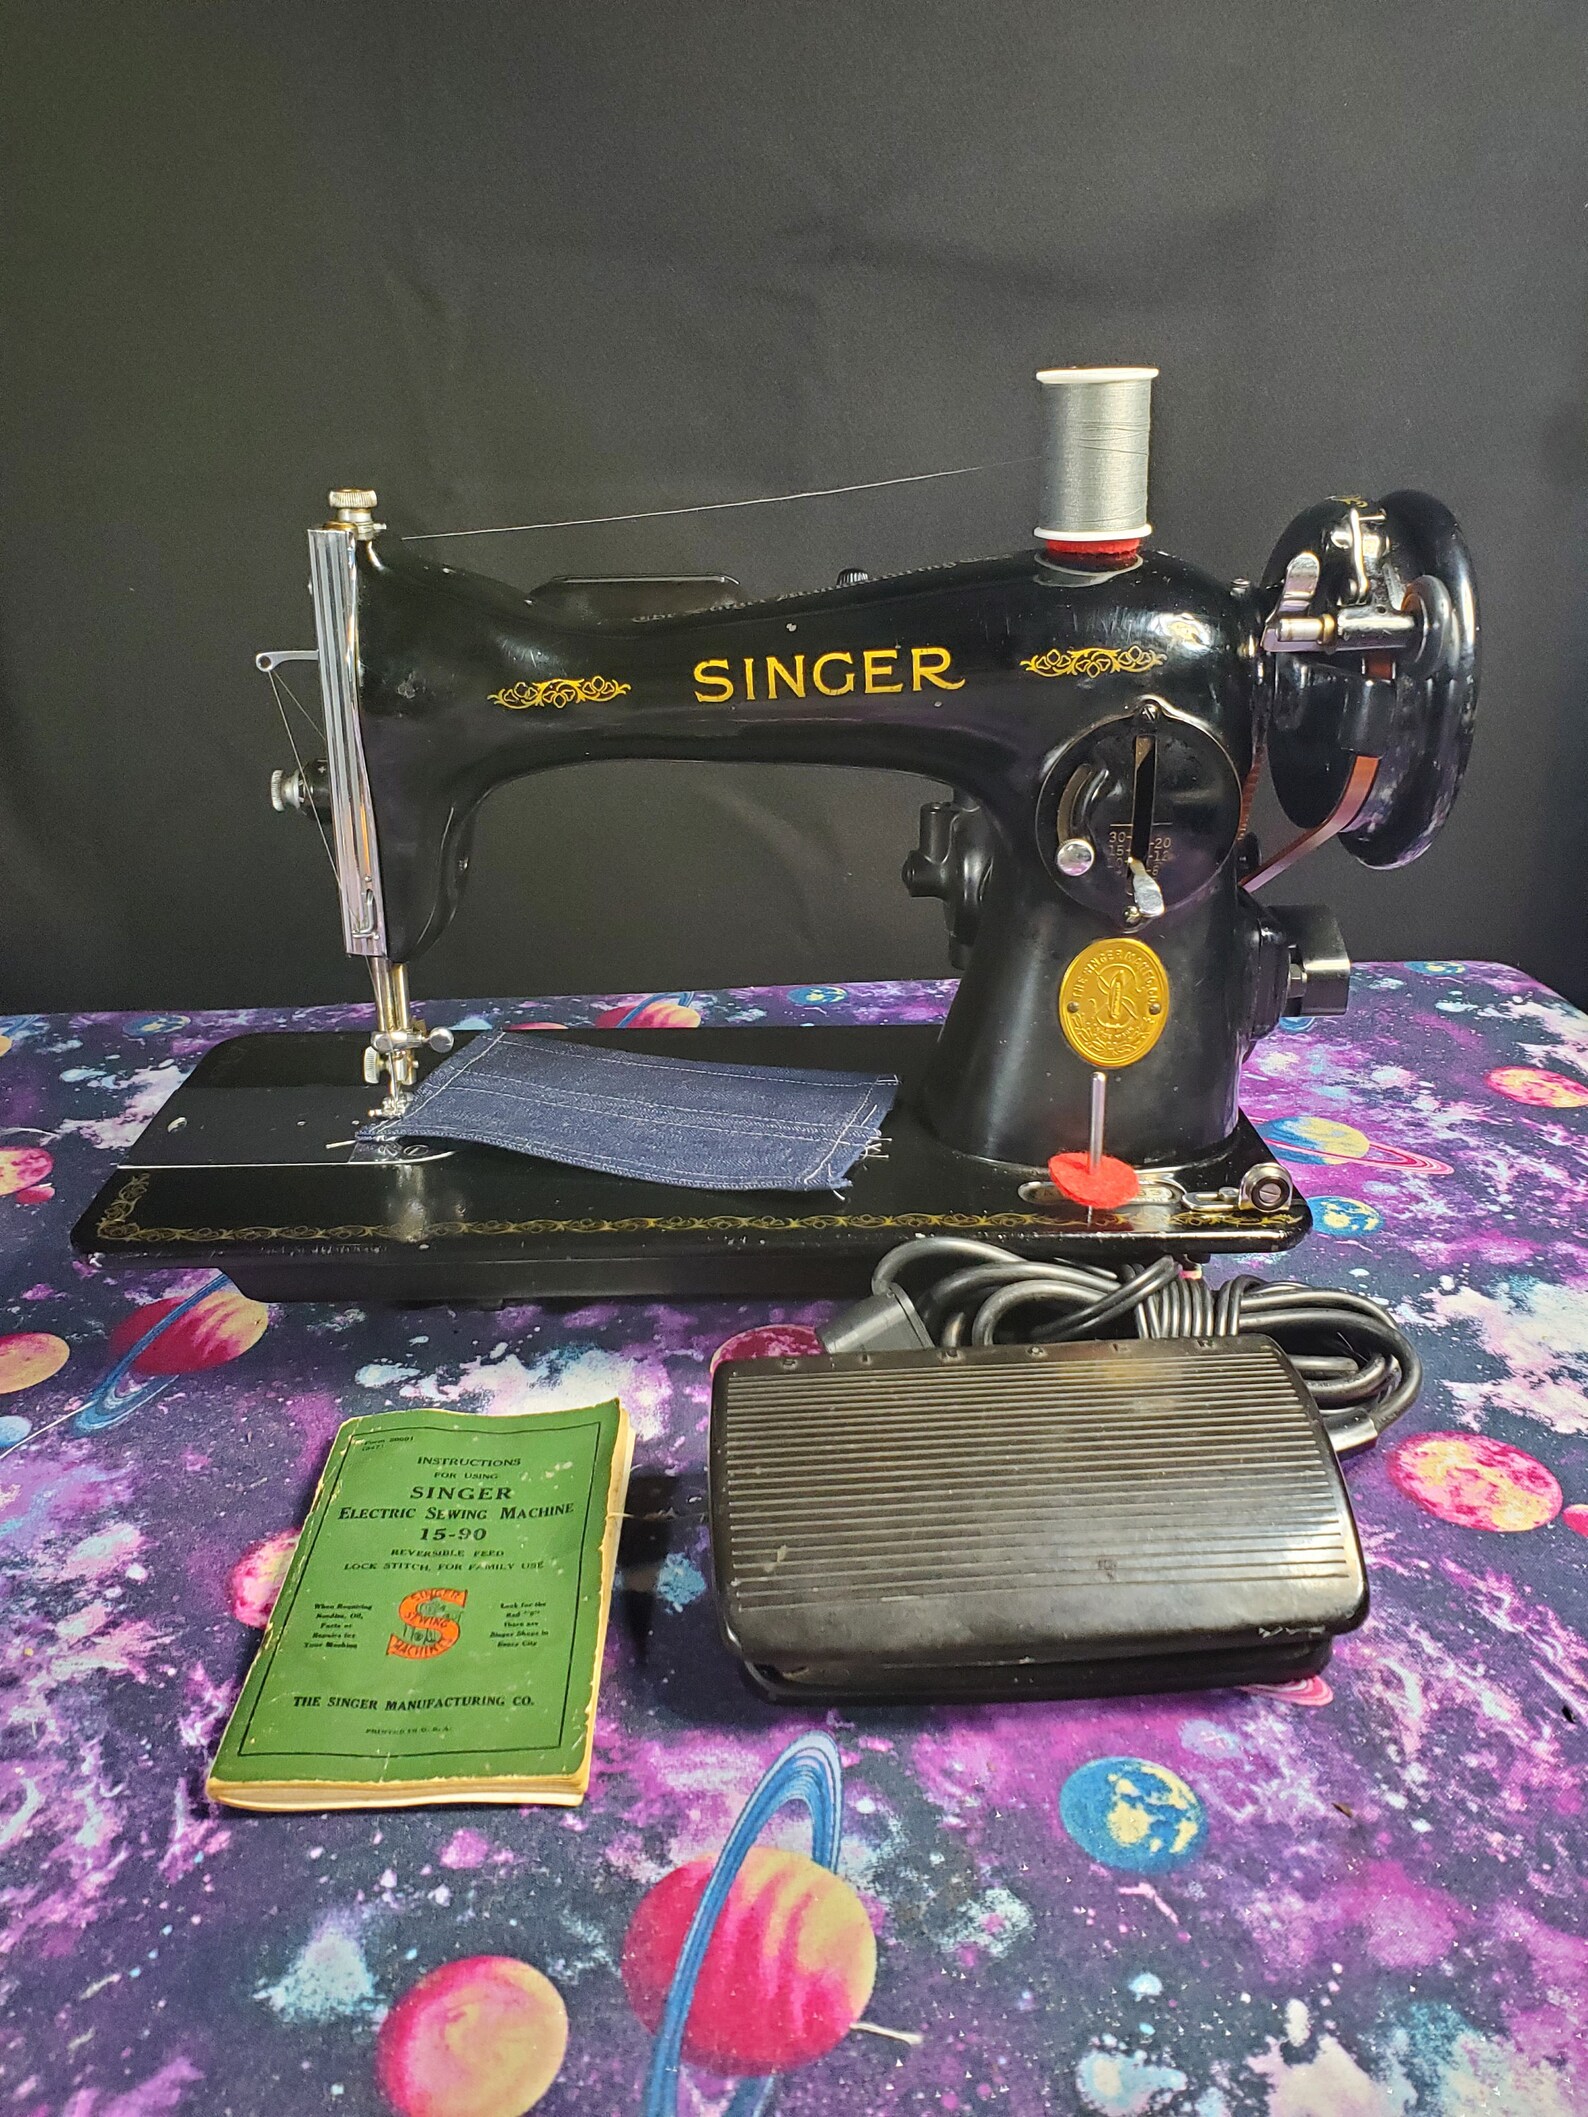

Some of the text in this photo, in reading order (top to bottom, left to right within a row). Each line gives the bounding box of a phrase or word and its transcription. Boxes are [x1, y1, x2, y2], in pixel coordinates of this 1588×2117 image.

[693, 646, 966, 703] SINGER
[1109, 831, 1127, 843] 30
[1154, 837, 1172, 849] 20
[1108, 844, 1125, 856] 15
[417, 1456, 521, 1467] INSTRUCTIONS
[433, 1472, 499, 1480] FOR USING
[410, 1486, 512, 1500] SINGER
[338, 1503, 574, 1520] ELECTRIC SEWING MACHINE
[420, 1527, 487, 1541] 15-90
[390, 1549, 465, 1558] REVERSIBLE
[438, 1563, 462, 1571] FOR
[468, 1563, 515, 1571] FAMILY
[293, 1696, 535, 1712] THE SINGER MANUFACTURING CO.
